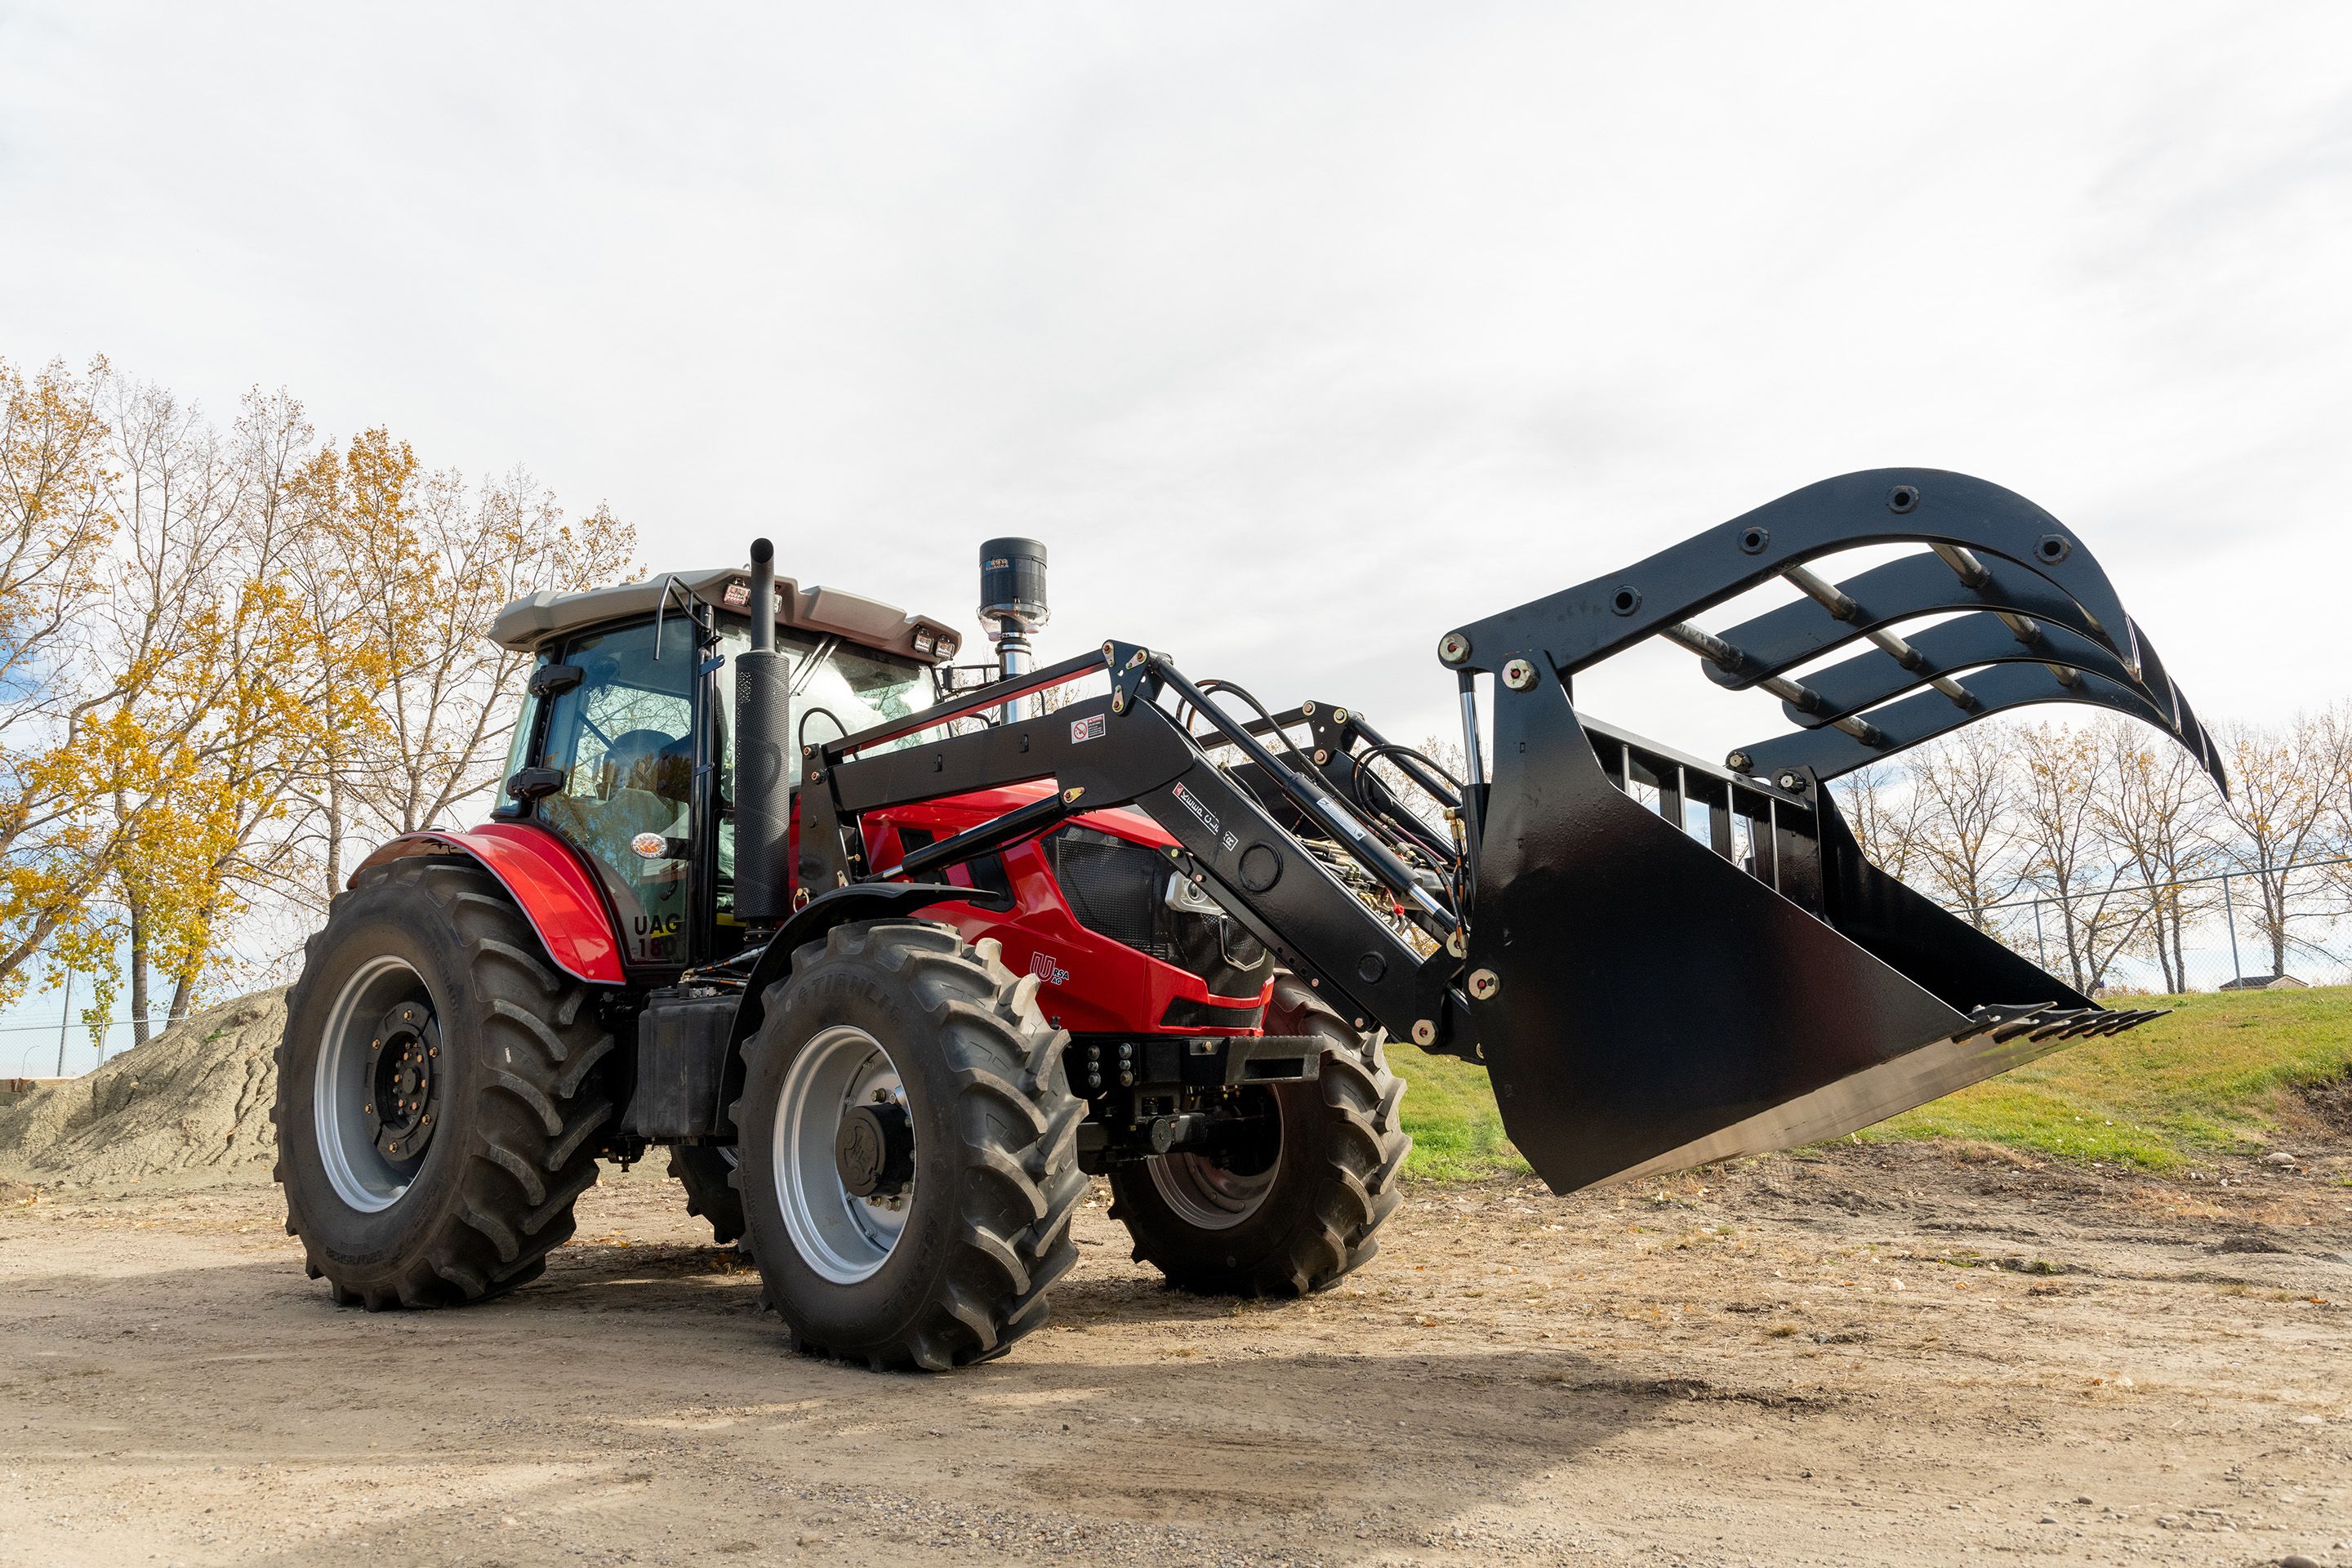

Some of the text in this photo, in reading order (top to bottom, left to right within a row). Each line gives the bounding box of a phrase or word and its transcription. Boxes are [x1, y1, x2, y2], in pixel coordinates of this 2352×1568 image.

[1181, 791, 1234, 847] KEEP CLR
[635, 914, 681, 935] UAG
[1051, 977, 1062, 985] AG
